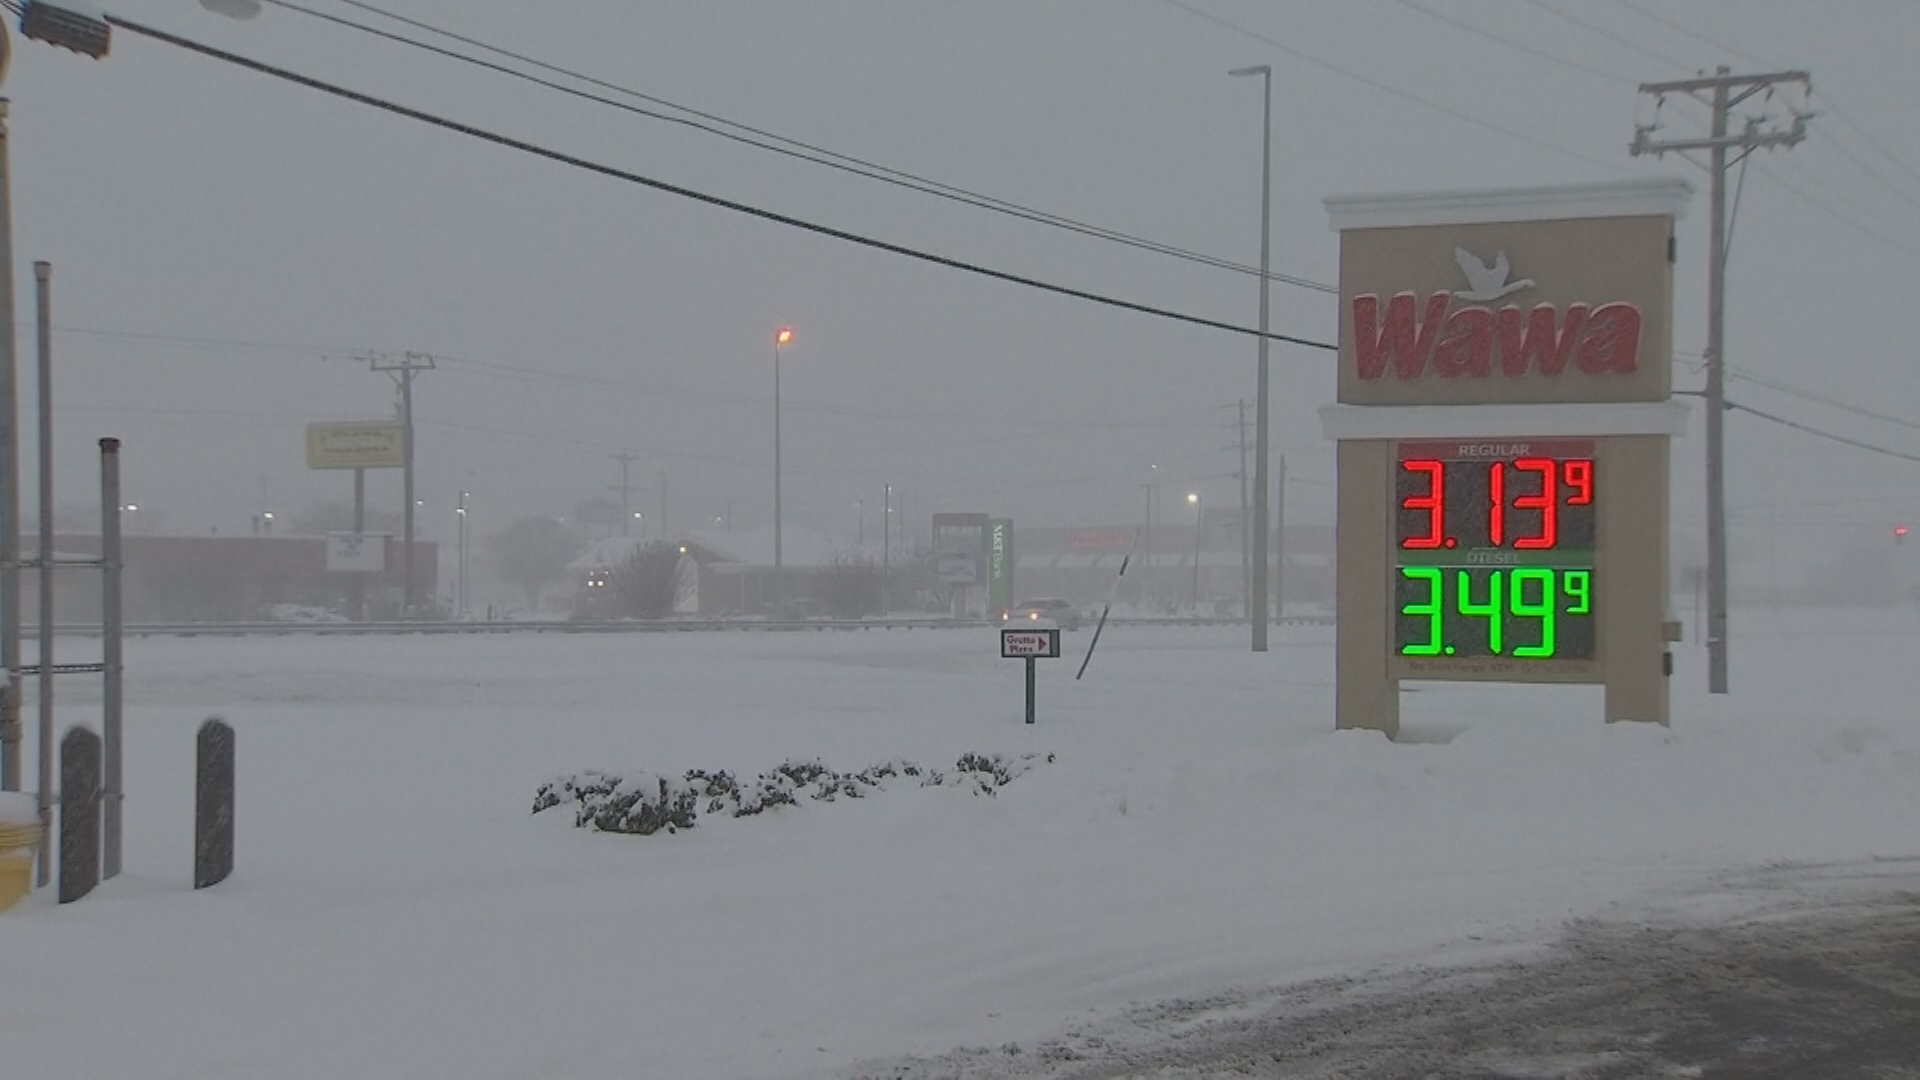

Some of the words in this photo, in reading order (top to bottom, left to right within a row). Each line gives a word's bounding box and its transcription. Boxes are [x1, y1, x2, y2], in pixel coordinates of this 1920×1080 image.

[1353, 290, 1641, 380] Wawa
[1458, 444, 1531, 457] REGULAR
[1466, 551, 1522, 564] DIESEL
